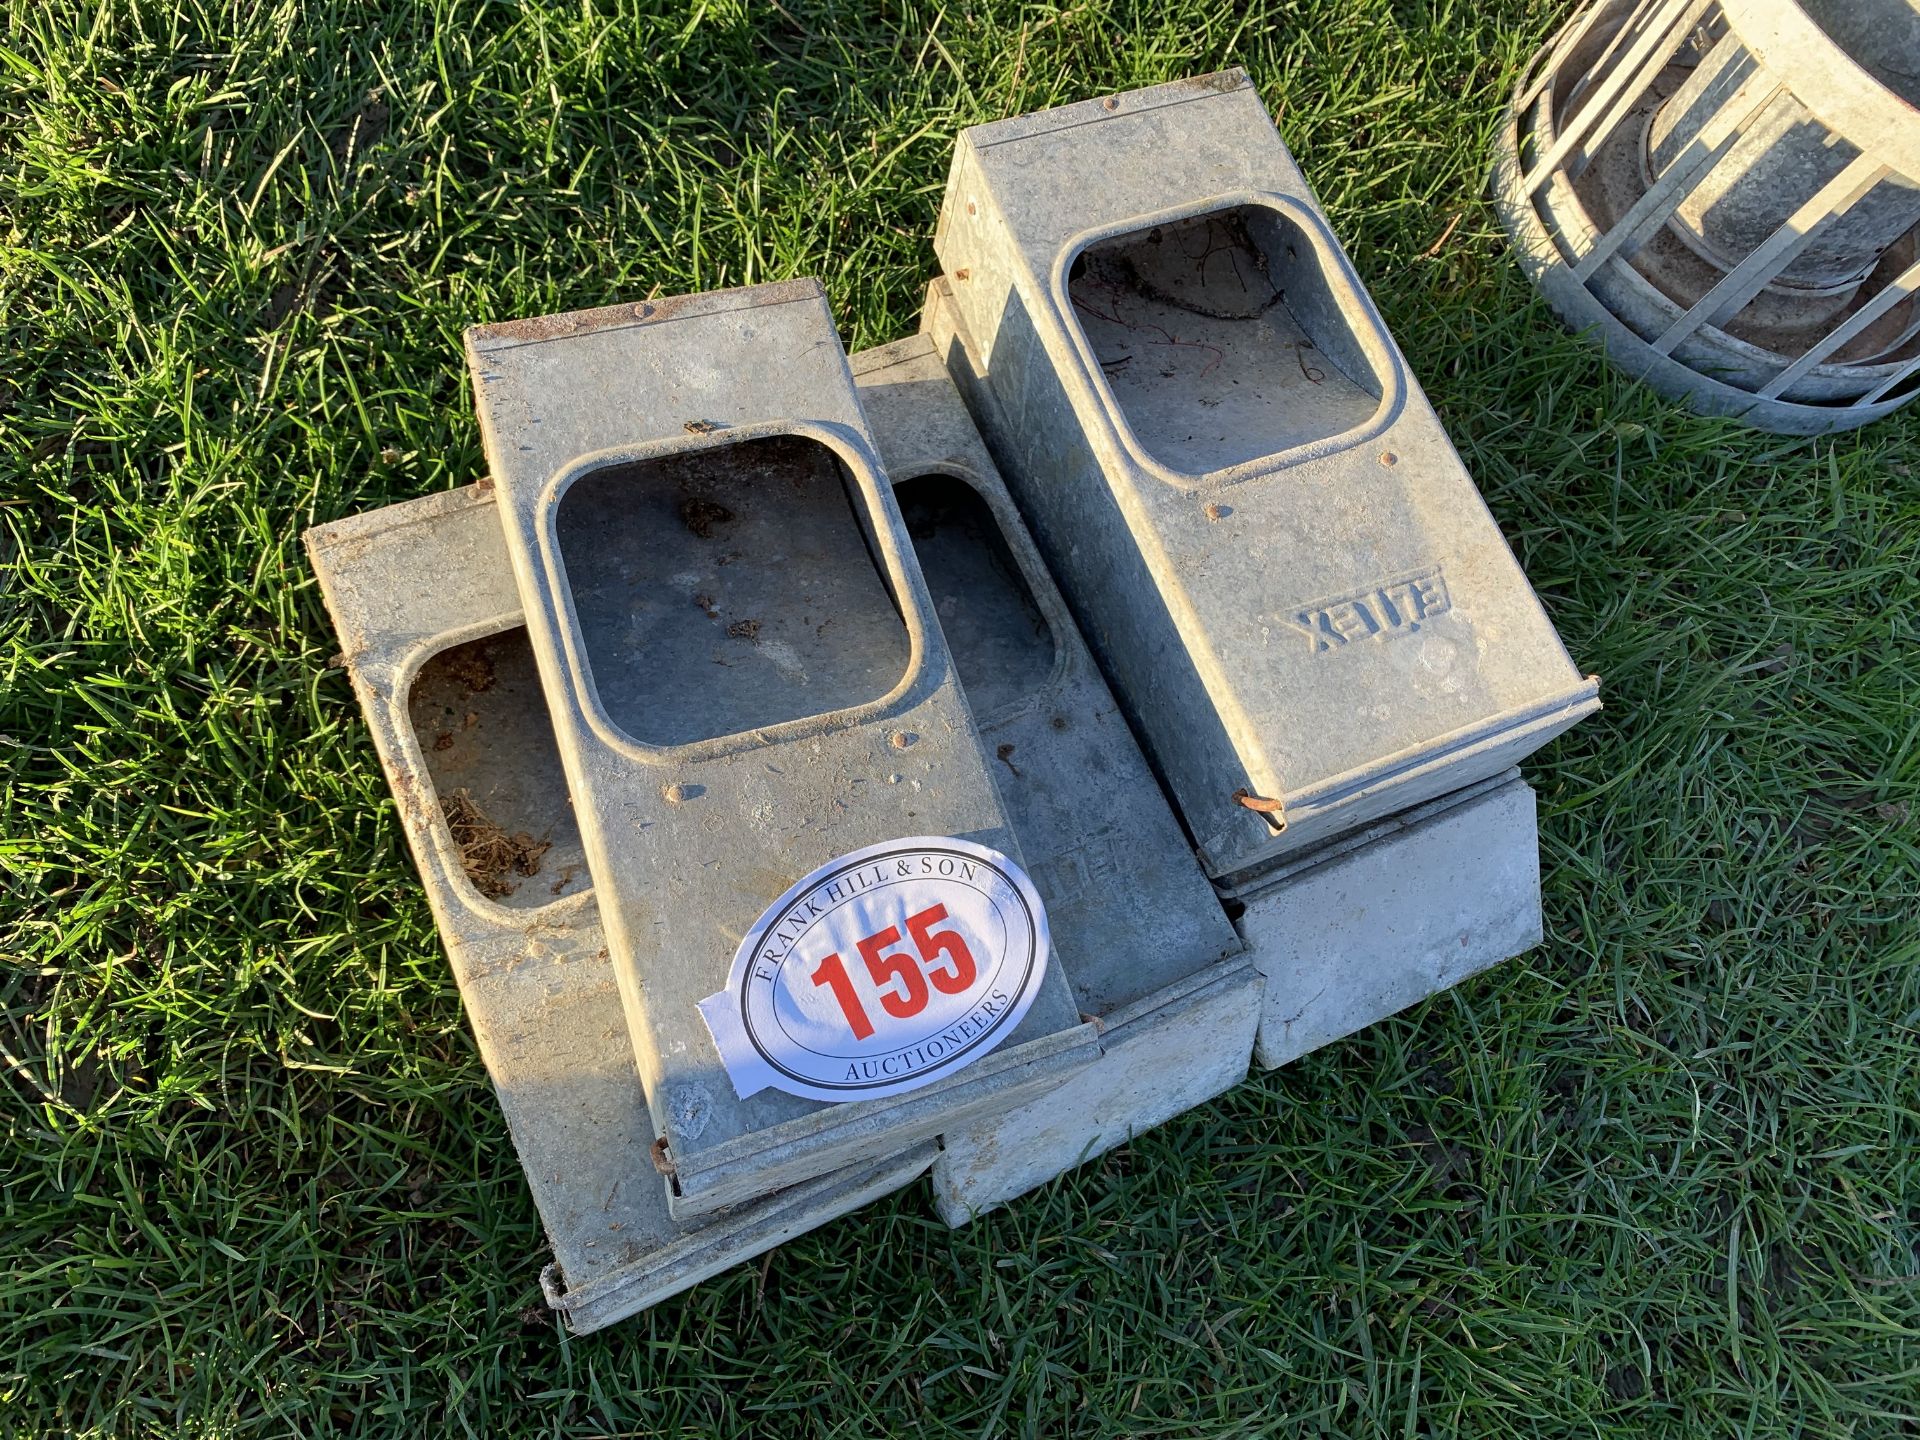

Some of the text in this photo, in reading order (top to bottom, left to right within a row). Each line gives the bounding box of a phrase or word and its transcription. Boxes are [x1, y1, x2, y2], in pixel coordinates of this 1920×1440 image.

[1275, 566, 1452, 653] ELTEX
[755, 856, 977, 984] FRANK HILL & SON
[810, 902, 977, 1041] 155
[844, 989, 1009, 1081] AUCTIONEERS
